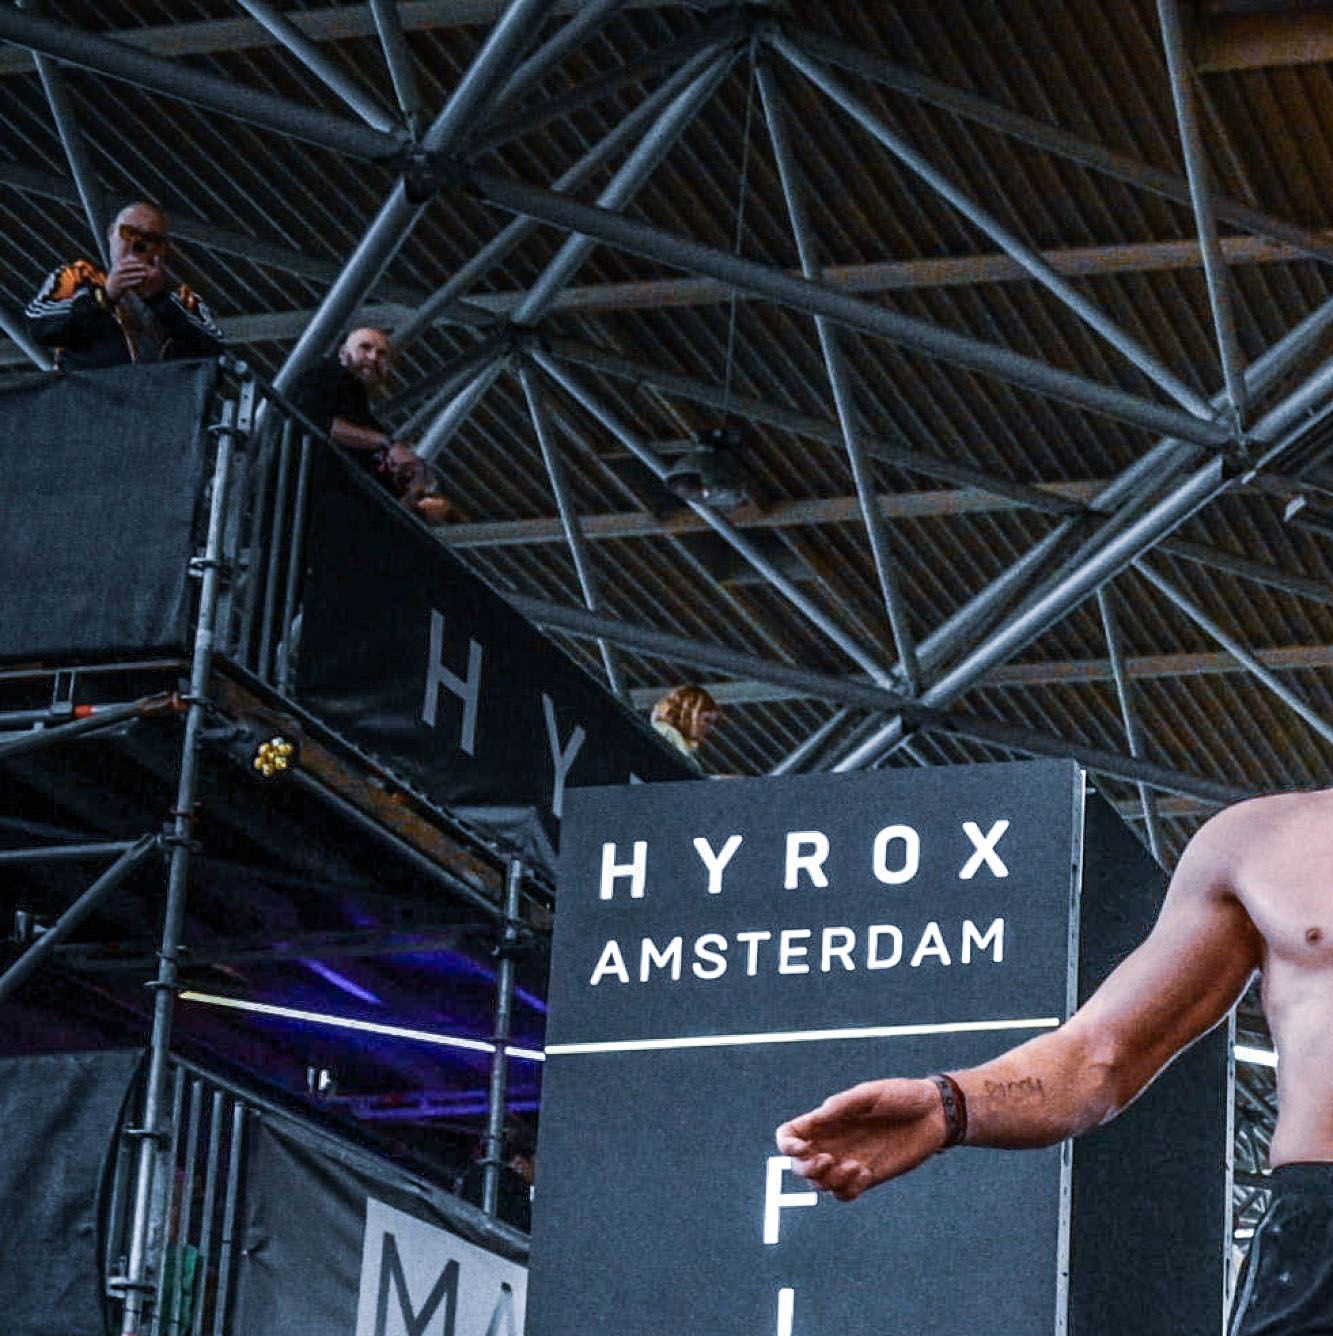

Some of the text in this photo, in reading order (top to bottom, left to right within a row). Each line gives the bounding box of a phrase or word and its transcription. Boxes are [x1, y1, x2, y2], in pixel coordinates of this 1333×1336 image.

[421, 608, 645, 818] HY
[599, 819, 1010, 901] HYROX
[589, 917, 1005, 986] AMSTERDAM
